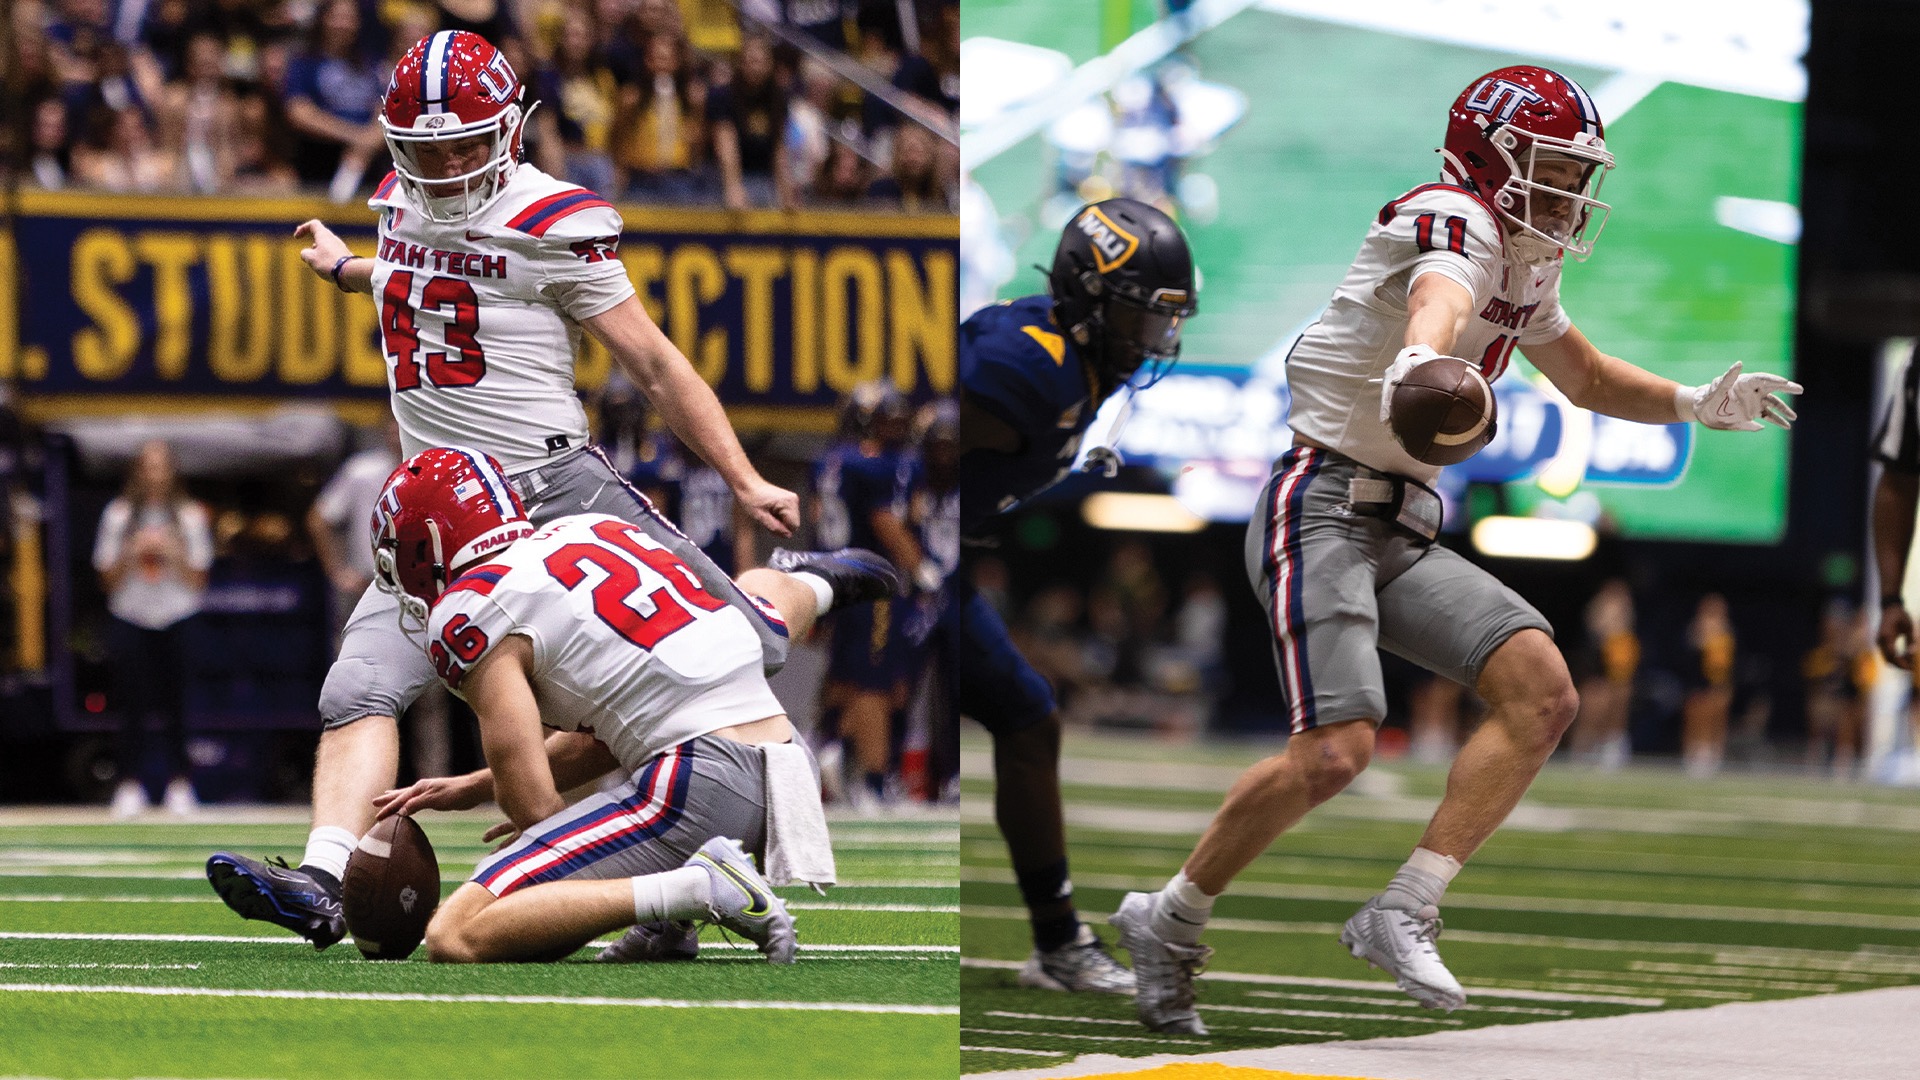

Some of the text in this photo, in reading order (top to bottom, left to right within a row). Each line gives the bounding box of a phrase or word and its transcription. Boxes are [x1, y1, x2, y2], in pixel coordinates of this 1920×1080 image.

[1465, 77, 1545, 123] UT
[1077, 212, 1127, 260] NAU
[1413, 212, 1469, 259] 11
[430, 249, 507, 280] TECH
[69, 227, 388, 388] STUDE
[574, 245, 957, 393] ECTION
[382, 270, 487, 393] 43
[1479, 296, 1522, 330] UTAH
[553, 439, 562, 448] L
[543, 519, 728, 653] 26
[429, 612, 489, 690] 26
